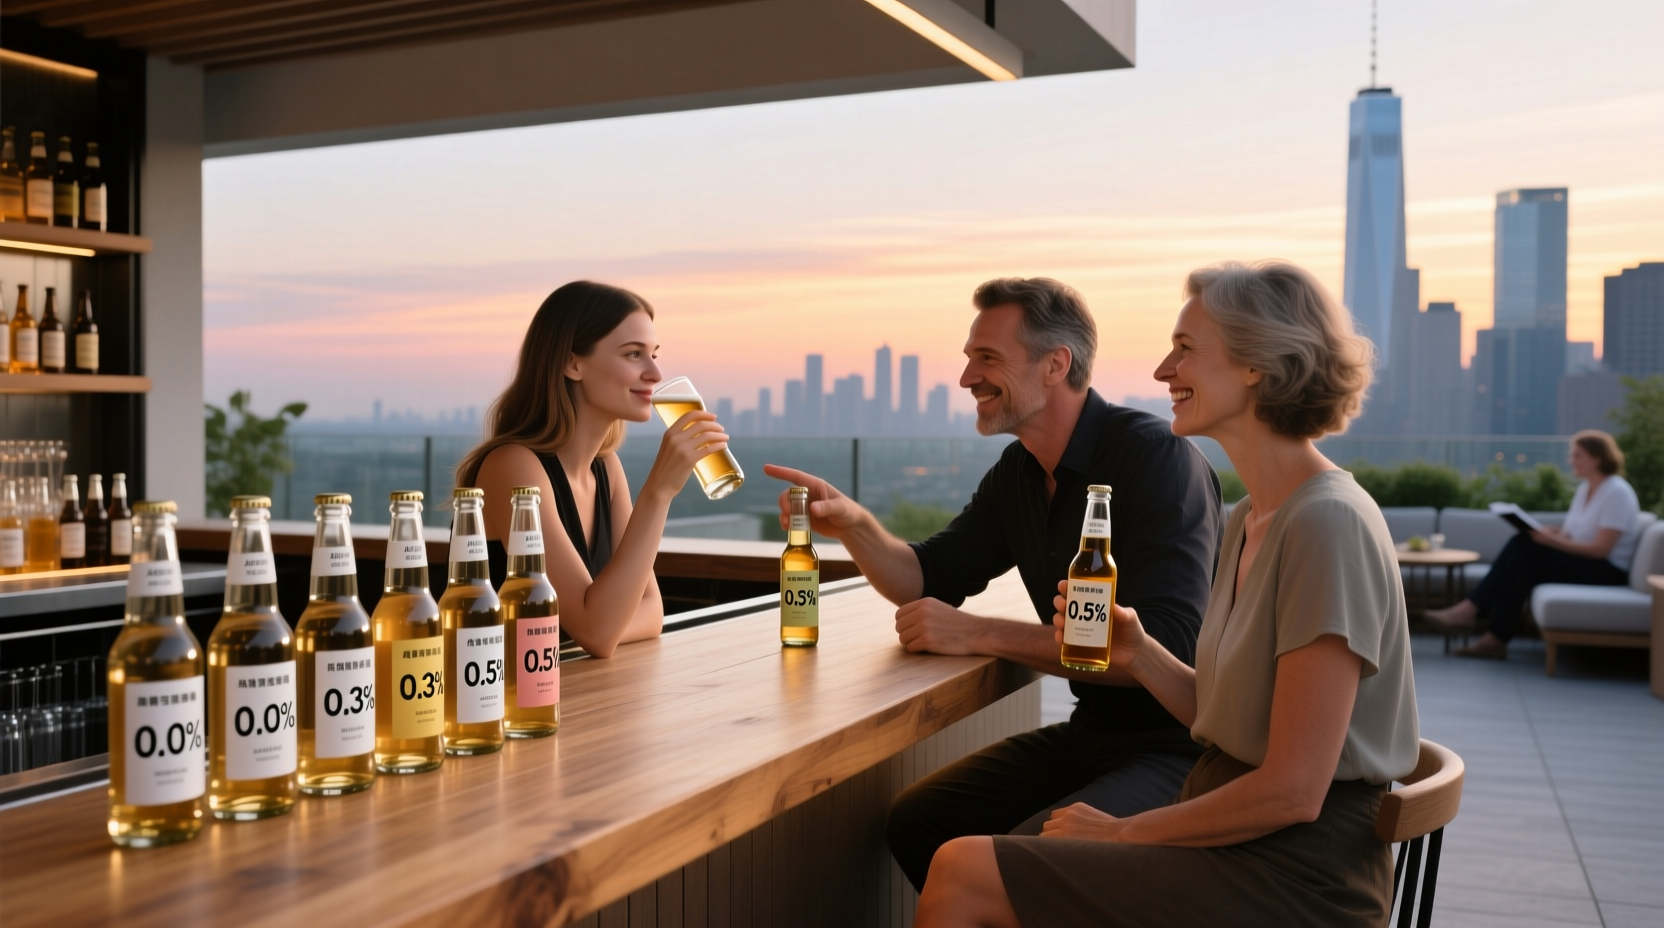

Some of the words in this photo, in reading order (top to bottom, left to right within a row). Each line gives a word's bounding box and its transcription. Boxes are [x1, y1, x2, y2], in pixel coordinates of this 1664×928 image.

[785, 590, 816, 606] 0.5%
[1068, 600, 1106, 622] 0.5%
[324, 684, 375, 717] 0.3%
[400, 671, 443, 700] 0.3%
[235, 701, 295, 736] 0.0%
[135, 719, 201, 758] 0.0%
